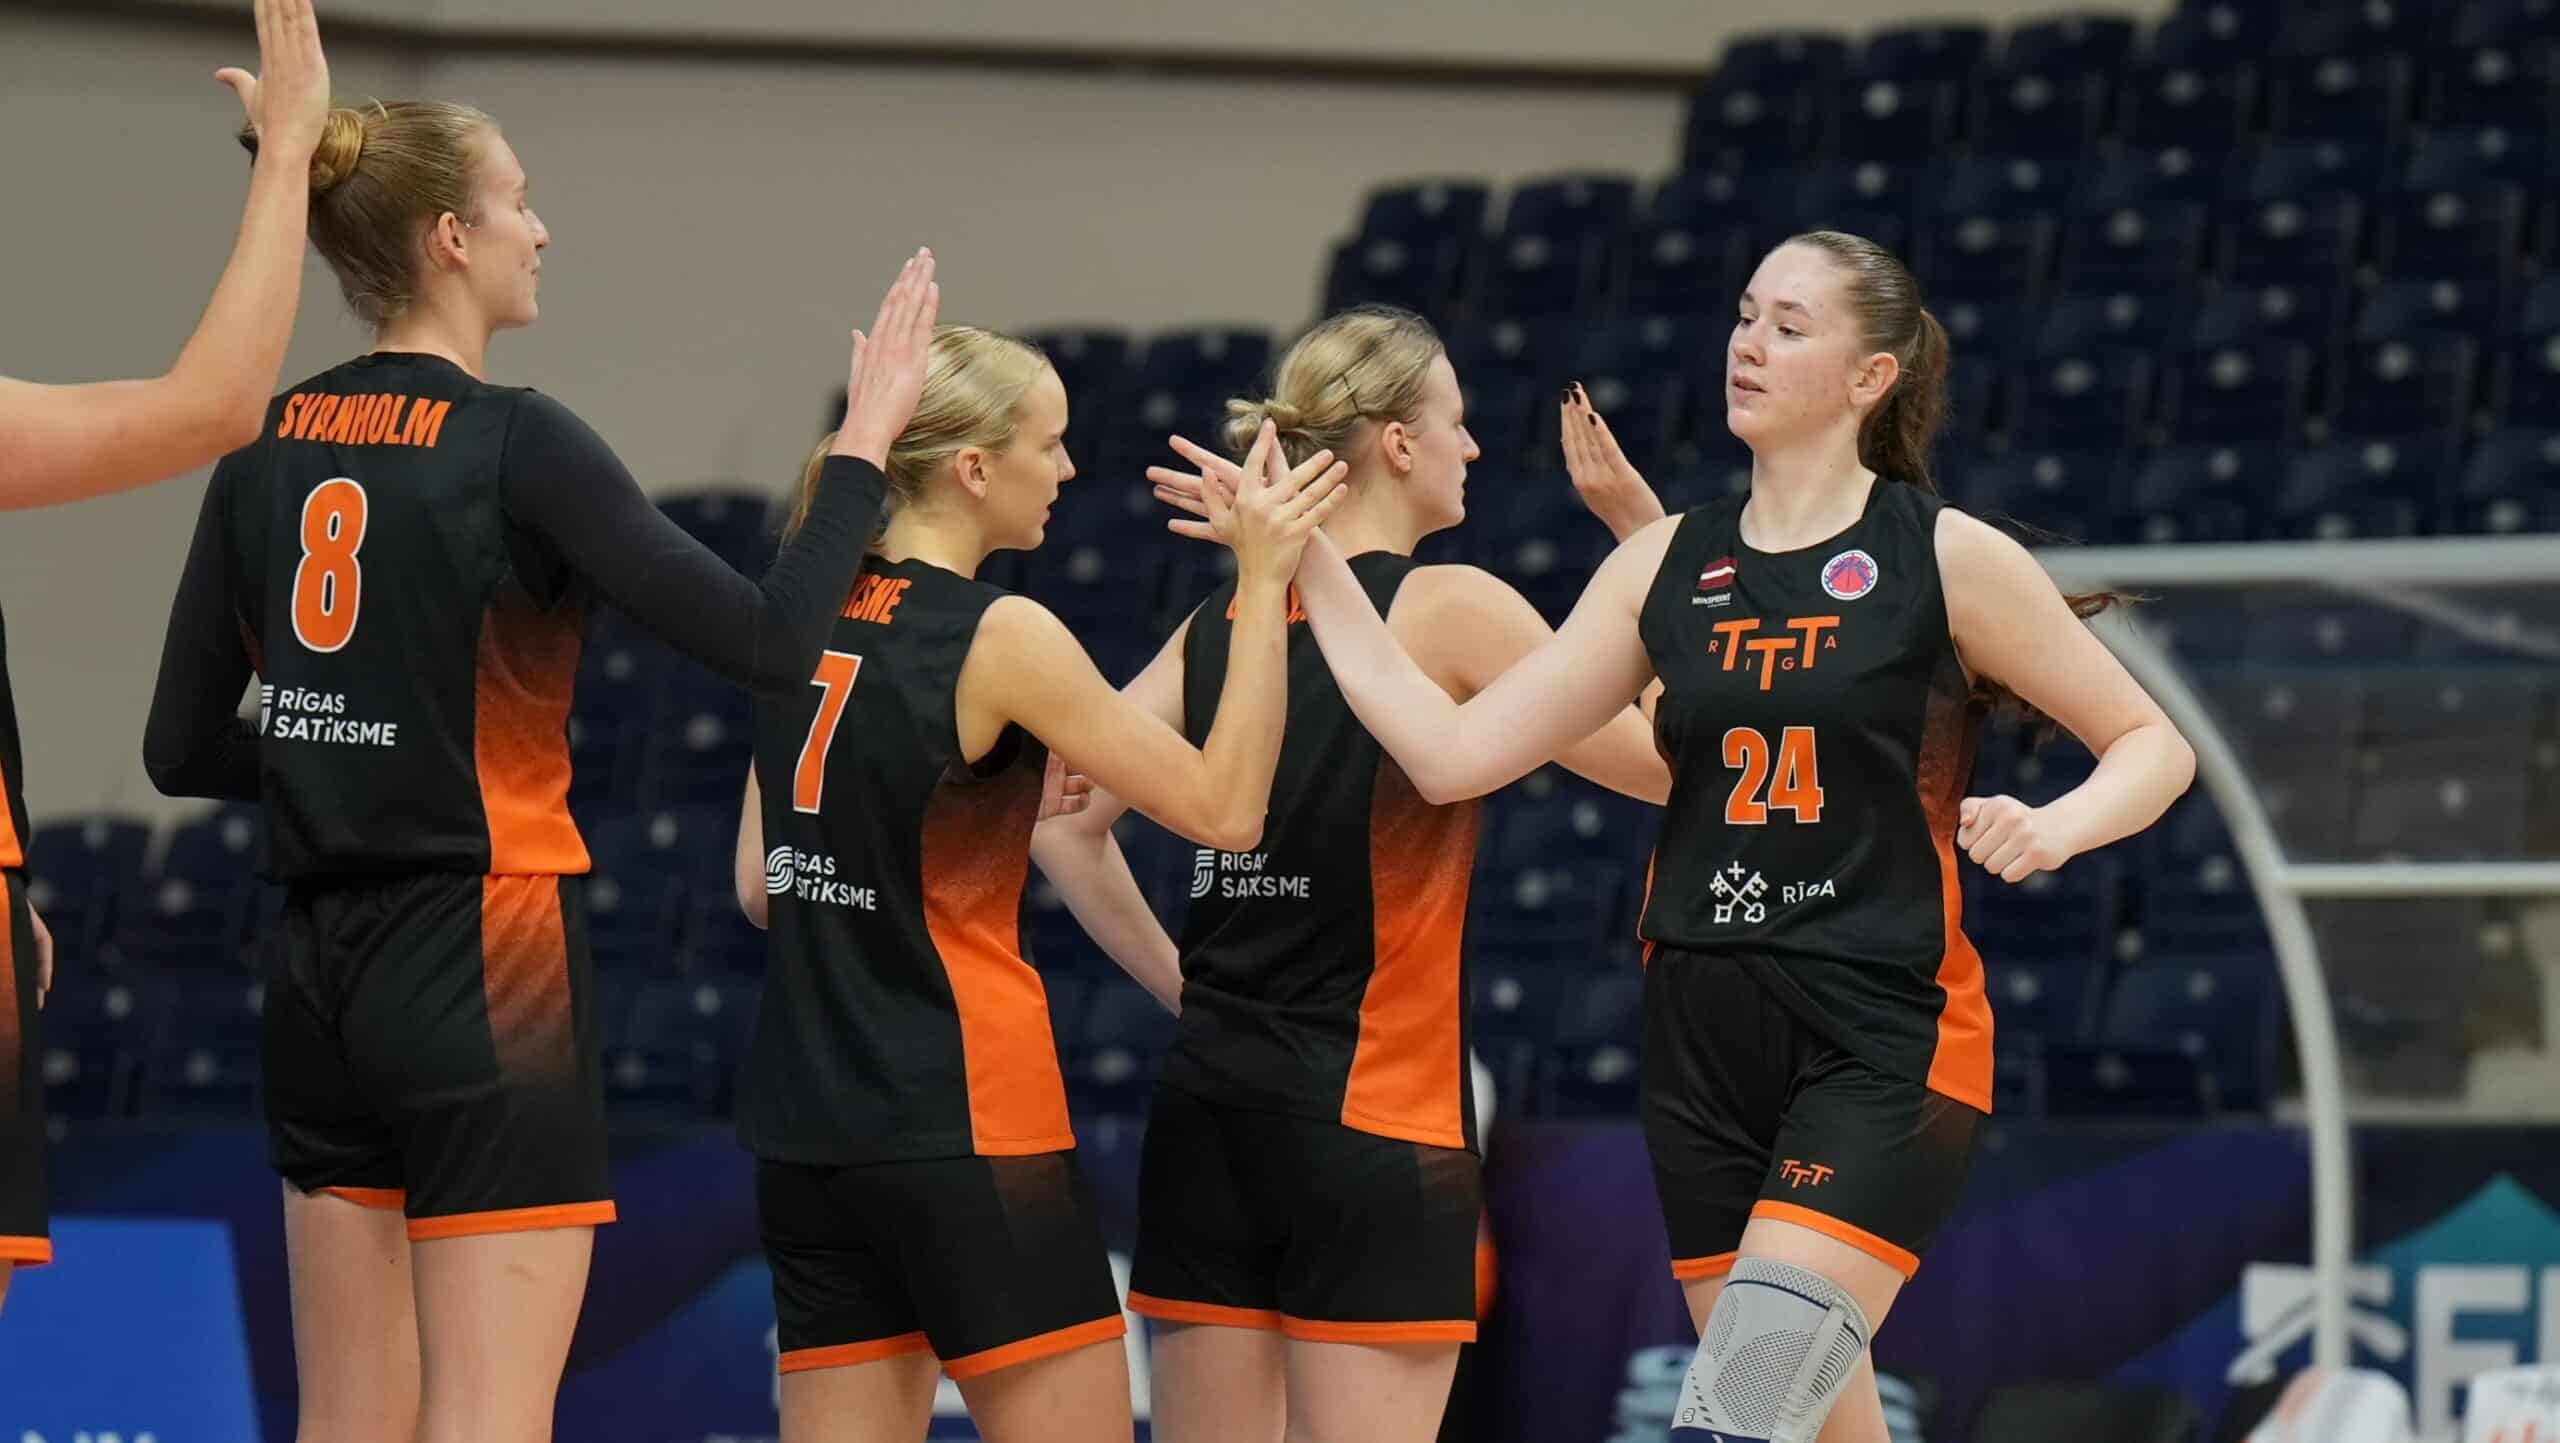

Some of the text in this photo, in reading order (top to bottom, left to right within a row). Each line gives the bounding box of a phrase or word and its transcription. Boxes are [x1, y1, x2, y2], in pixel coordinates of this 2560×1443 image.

[278, 393, 452, 448] SVANHOLM
[291, 476, 368, 653] 8
[278, 687, 345, 714] RĪGAS
[793, 649, 863, 815] 7
[1721, 726, 1824, 824] 24
